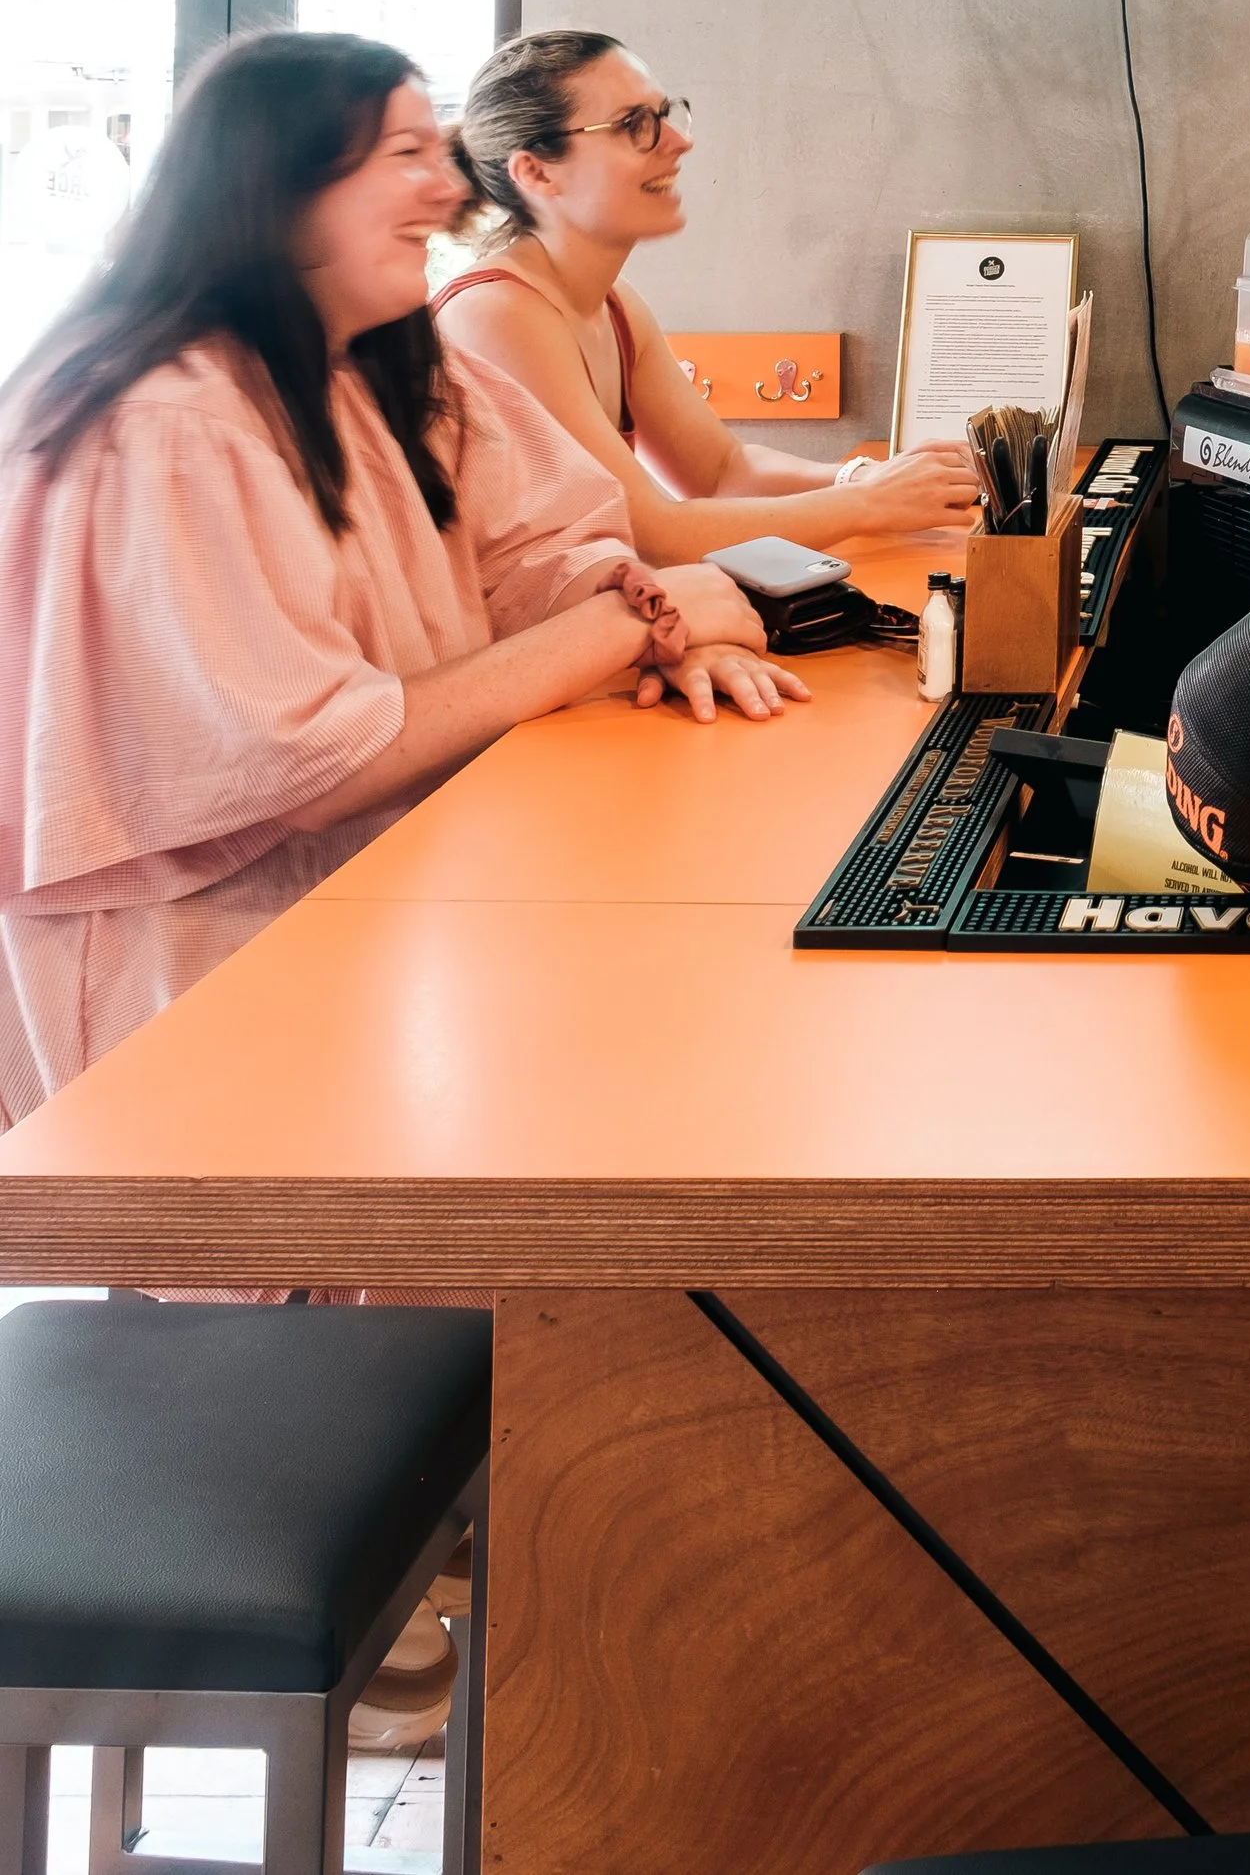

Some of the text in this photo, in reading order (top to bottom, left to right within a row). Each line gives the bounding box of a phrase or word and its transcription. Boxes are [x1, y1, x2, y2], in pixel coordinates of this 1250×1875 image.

[1166, 756, 1226, 856] DING
[885, 803, 973, 889] RESERVE
[1171, 860, 1200, 876] ALCOHOL
[1202, 867, 1218, 880] WILL
[1164, 878, 1190, 894] SERVED
